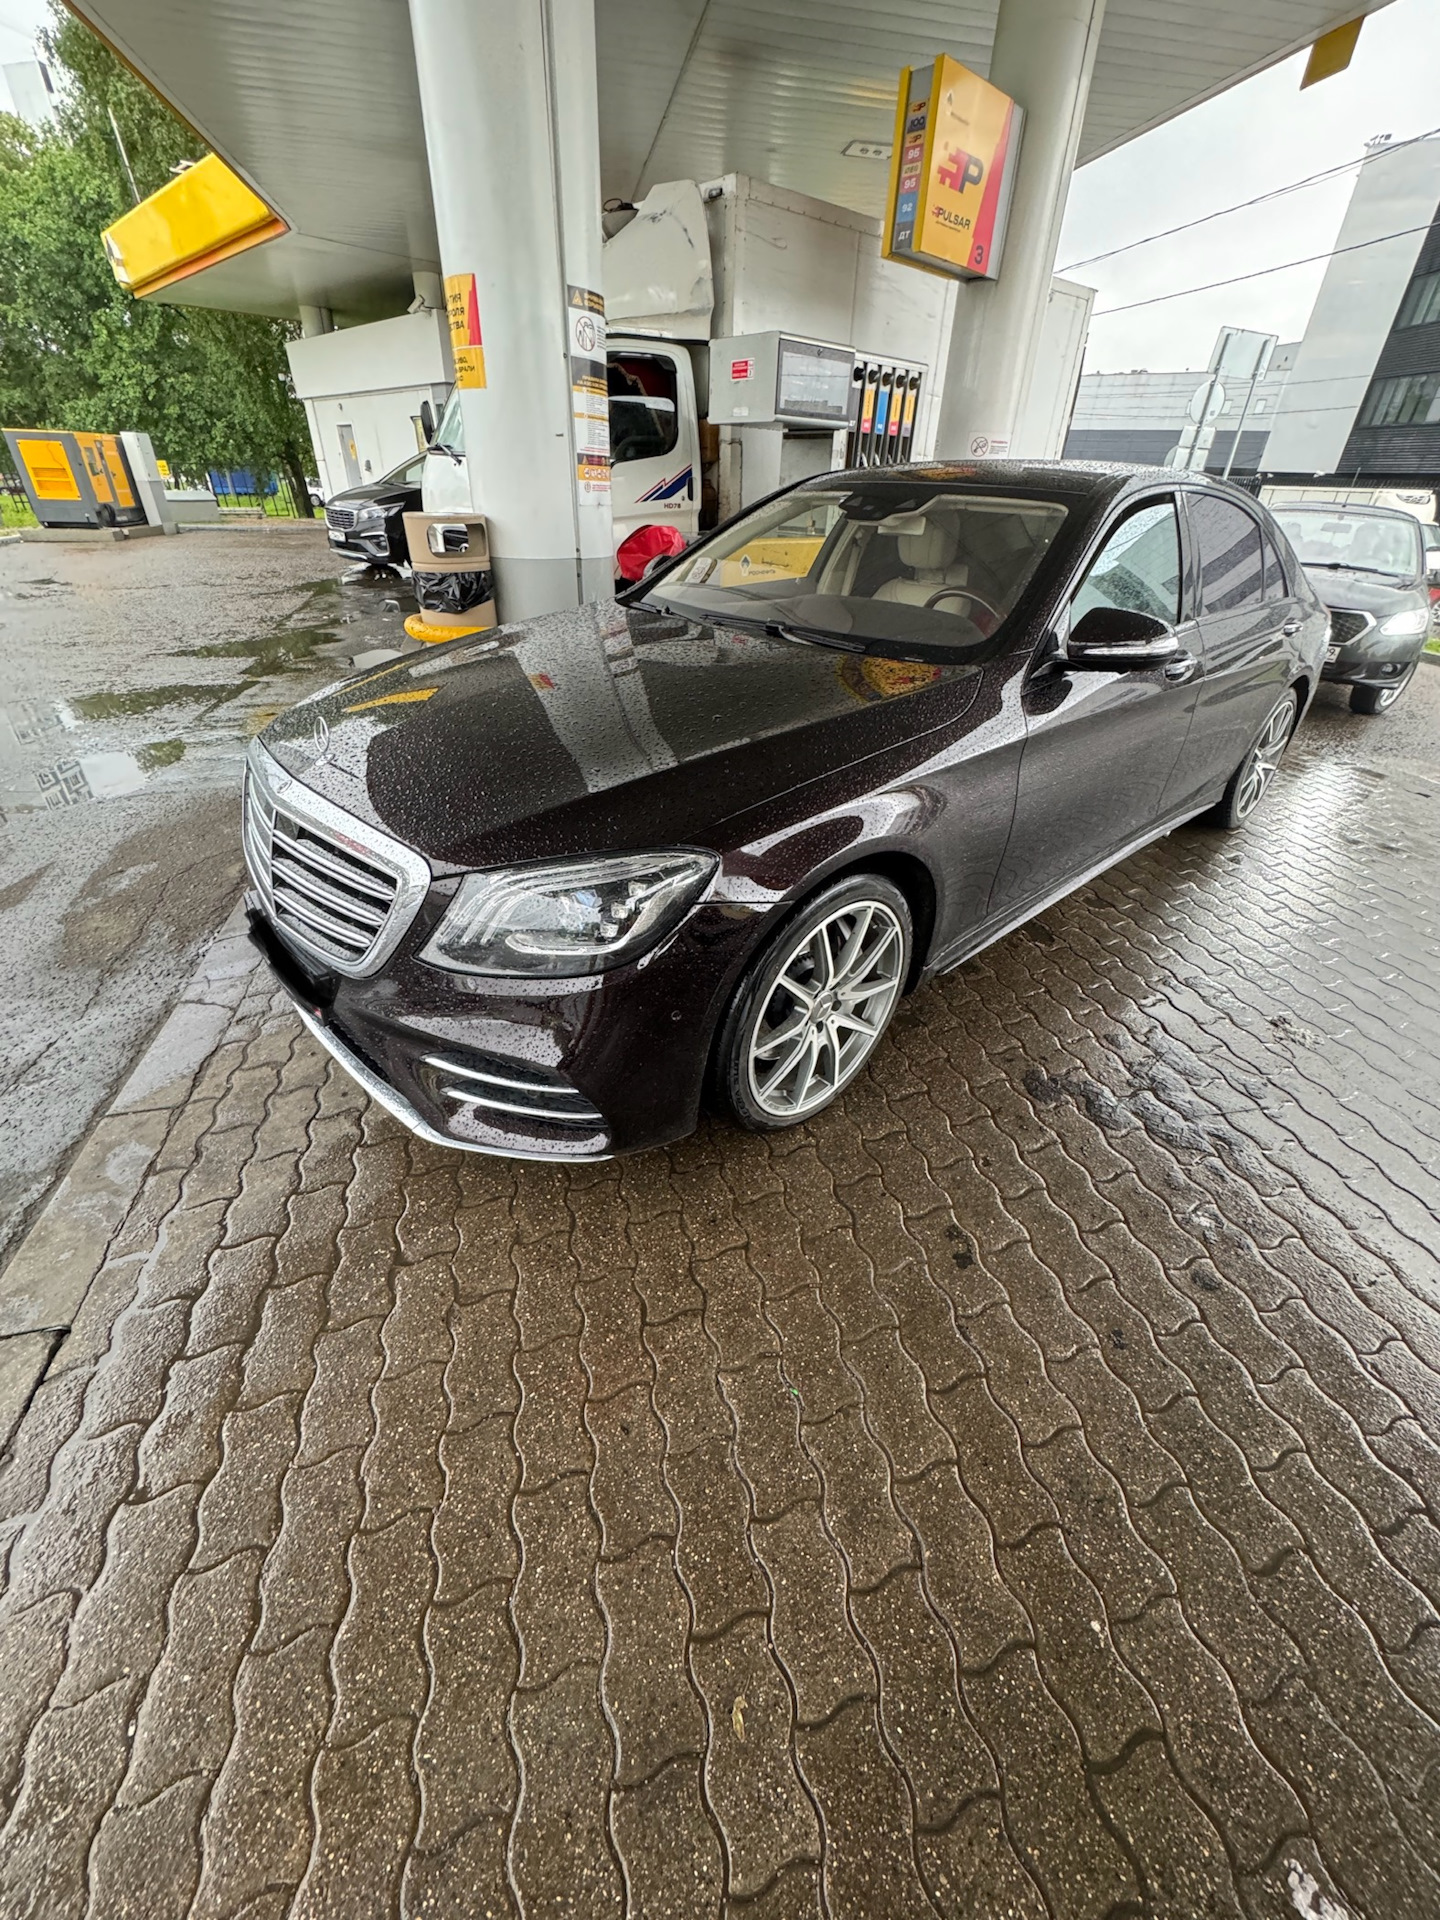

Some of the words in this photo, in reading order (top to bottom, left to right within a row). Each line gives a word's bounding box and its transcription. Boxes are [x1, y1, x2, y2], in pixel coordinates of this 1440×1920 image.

[907, 147, 920, 160] 95
[904, 177, 916, 189] 95
[901, 202, 913, 213] 92
[937, 207, 971, 230] PULSAR
[898, 230, 911, 242] ДТ
[974, 245, 984, 265] 3
